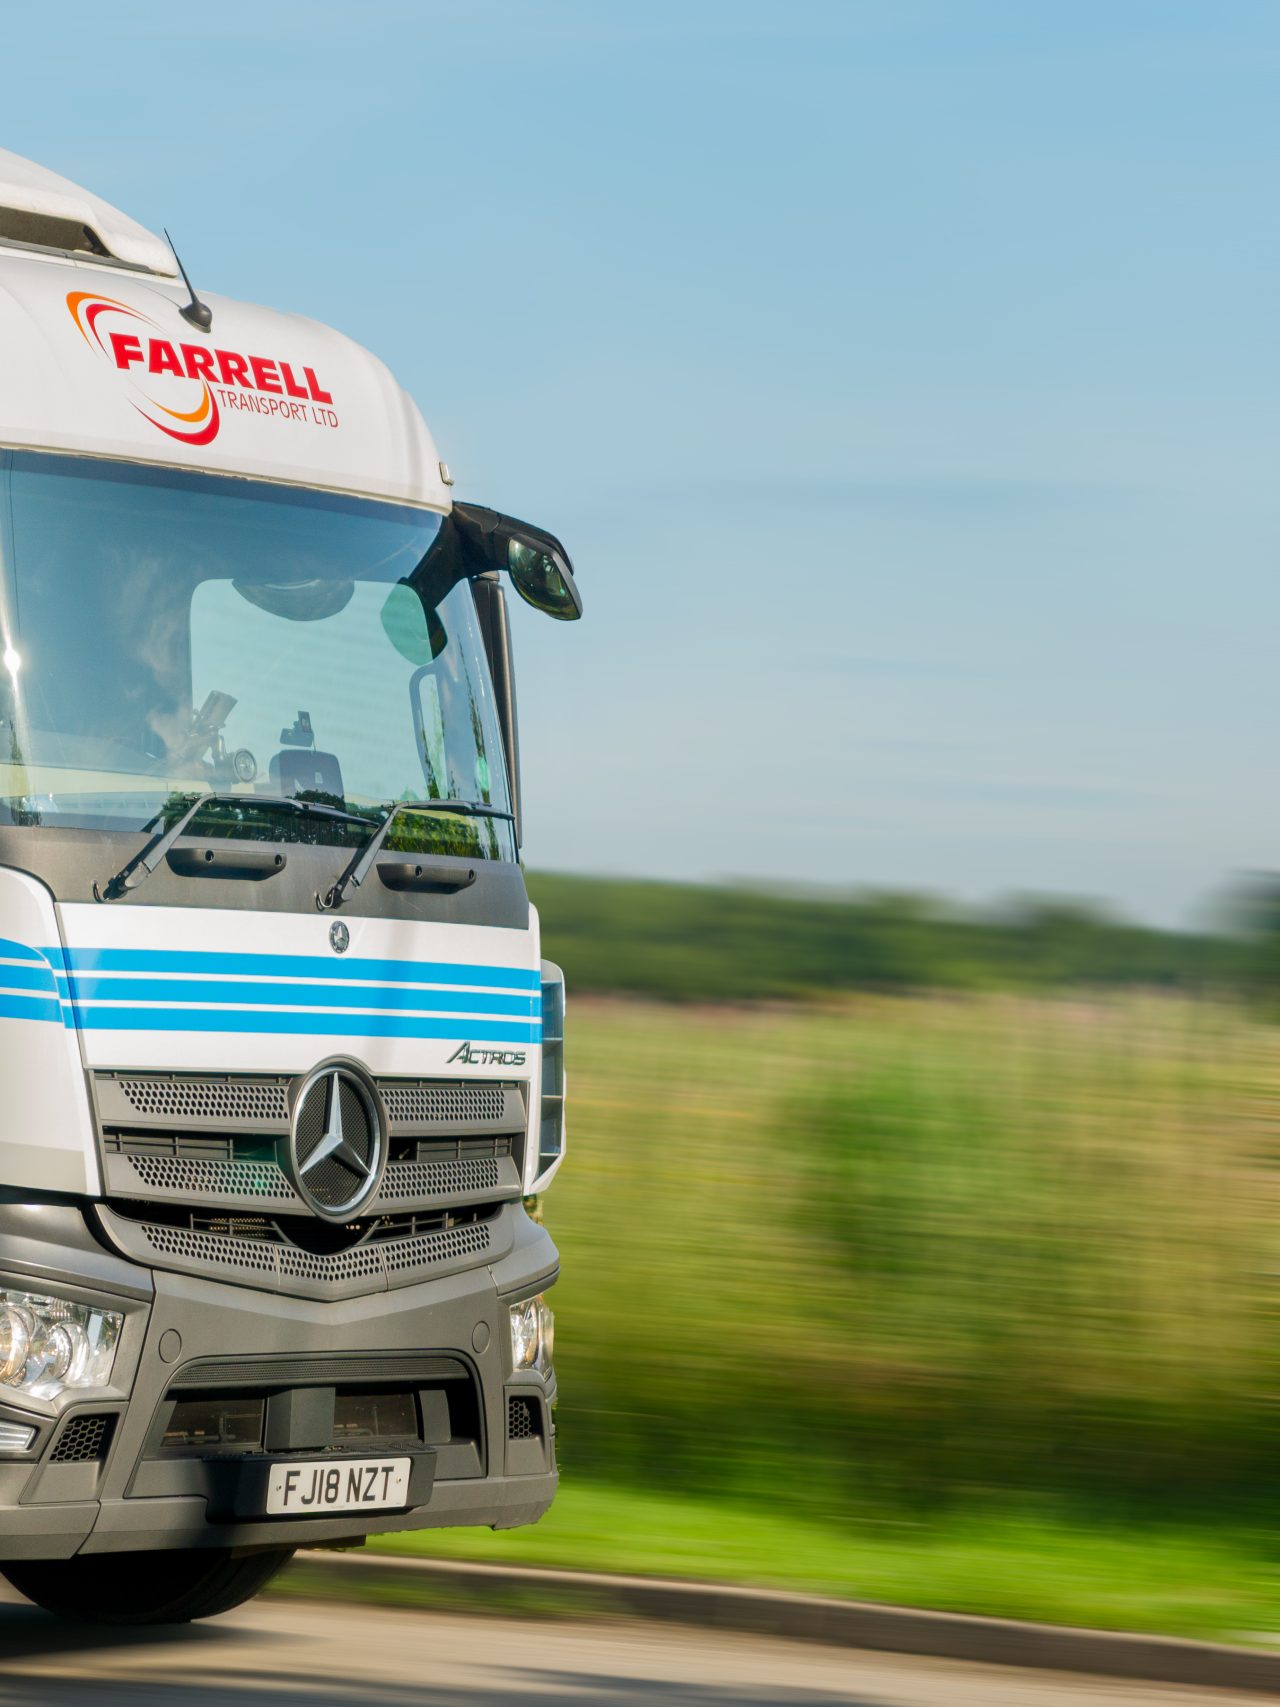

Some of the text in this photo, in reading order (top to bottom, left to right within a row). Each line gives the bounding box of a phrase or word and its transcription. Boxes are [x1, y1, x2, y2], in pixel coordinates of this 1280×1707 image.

[109, 332, 333, 405] FARRELL
[217, 388, 339, 428] TRANSPORT LTD
[283, 1466, 395, 1506] FJ18 NZT
